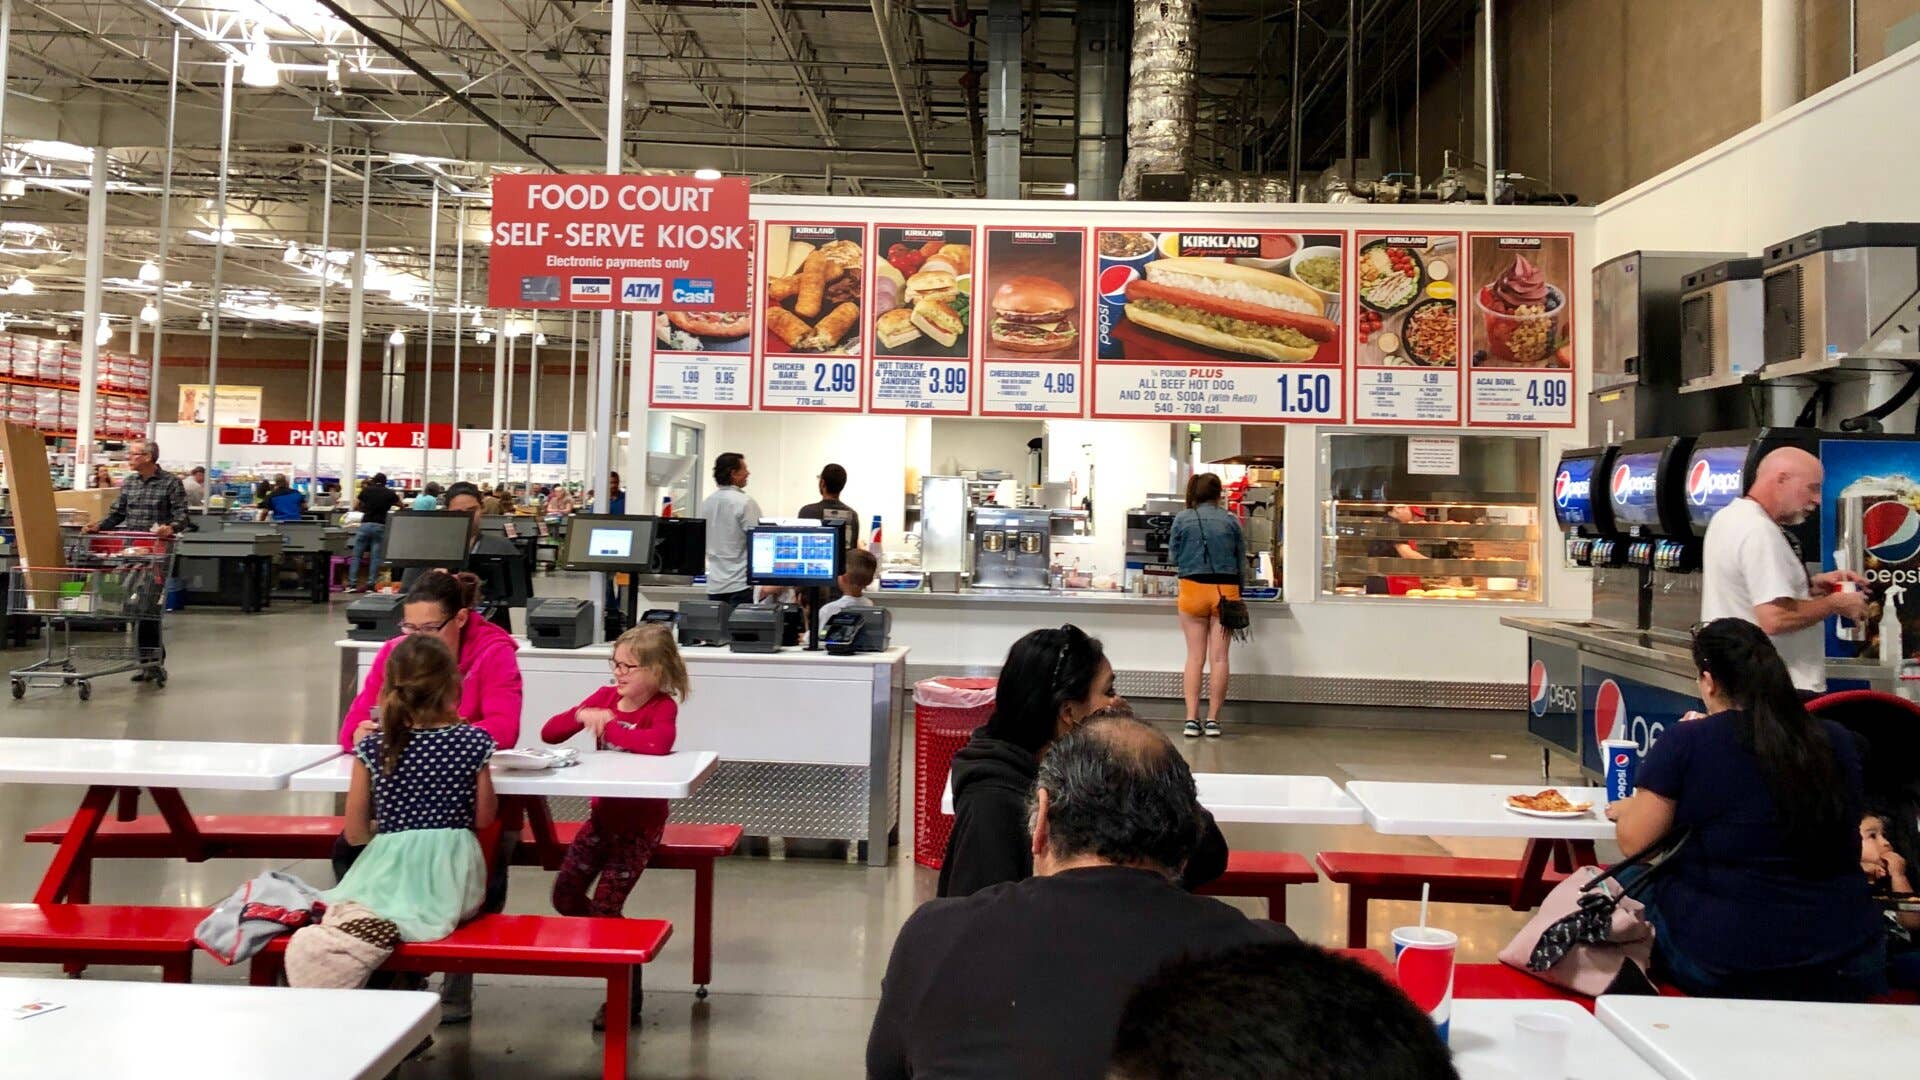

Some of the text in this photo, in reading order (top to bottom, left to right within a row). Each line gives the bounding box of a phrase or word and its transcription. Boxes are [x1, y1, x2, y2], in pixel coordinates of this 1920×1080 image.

[527, 184, 714, 212] FOOD COURT
[658, 224, 744, 249] KIOSK
[1015, 231, 1054, 239] KIRKLAND
[1182, 235, 1259, 248] KIRKLAND
[546, 255, 690, 271] Electronic payments only
[624, 283, 660, 297] ATM
[673, 289, 715, 304] Cash
[1098, 303, 1112, 345] pepsi
[896, 362, 924, 370] TURKEY
[1160, 370, 1187, 378] POUND
[1189, 369, 1224, 378] PLUS
[779, 371, 798, 379] BAKE
[814, 363, 856, 392] 2.99
[883, 370, 927, 378] PROVOLONE
[929, 367, 966, 393] 3.99
[990, 370, 1040, 378] CHEESEBURGER
[1044, 373, 1074, 394] 4.99
[1139, 379, 1234, 390] ALL BEEF HOT DOG
[1496, 378, 1516, 386] BOWL
[1119, 390, 1140, 400] AND
[1144, 391, 1156, 400] 20
[1177, 391, 1205, 401] SODA
[1277, 373, 1331, 413] 1.50
[1526, 379, 1566, 406] 4.99
[1154, 403, 1173, 412] 540
[1568, 478, 1591, 499] pepsi
[1628, 472, 1656, 494] pepsi
[1707, 469, 1742, 494] pepsi
